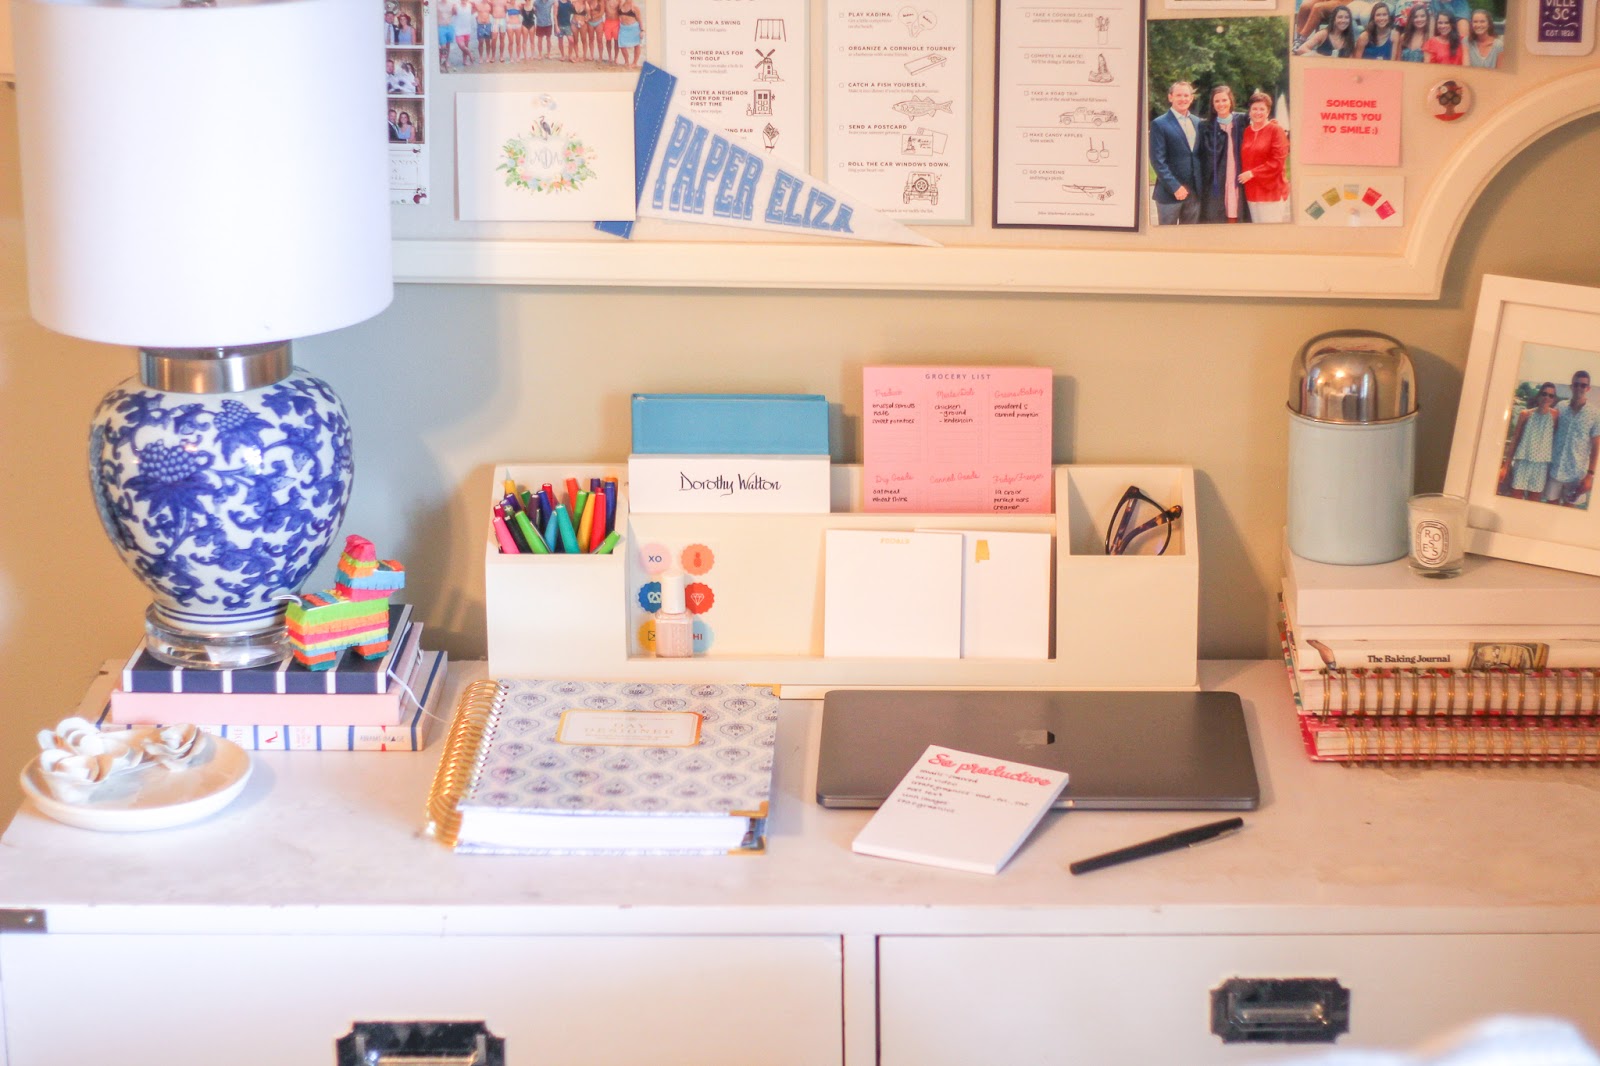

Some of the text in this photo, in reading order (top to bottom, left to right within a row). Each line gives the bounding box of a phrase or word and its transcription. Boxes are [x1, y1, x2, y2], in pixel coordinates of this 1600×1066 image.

[1552, 8, 1570, 20] SC
[1326, 100, 1377, 108] SOMEONE
[1320, 112, 1382, 122] WANTS YOU
[1322, 125, 1336, 135] TO
[652, 114, 854, 233] PAPER ELIZA
[679, 472, 782, 497] Dorothy Walton
[1384, 655, 1416, 665] Baking
